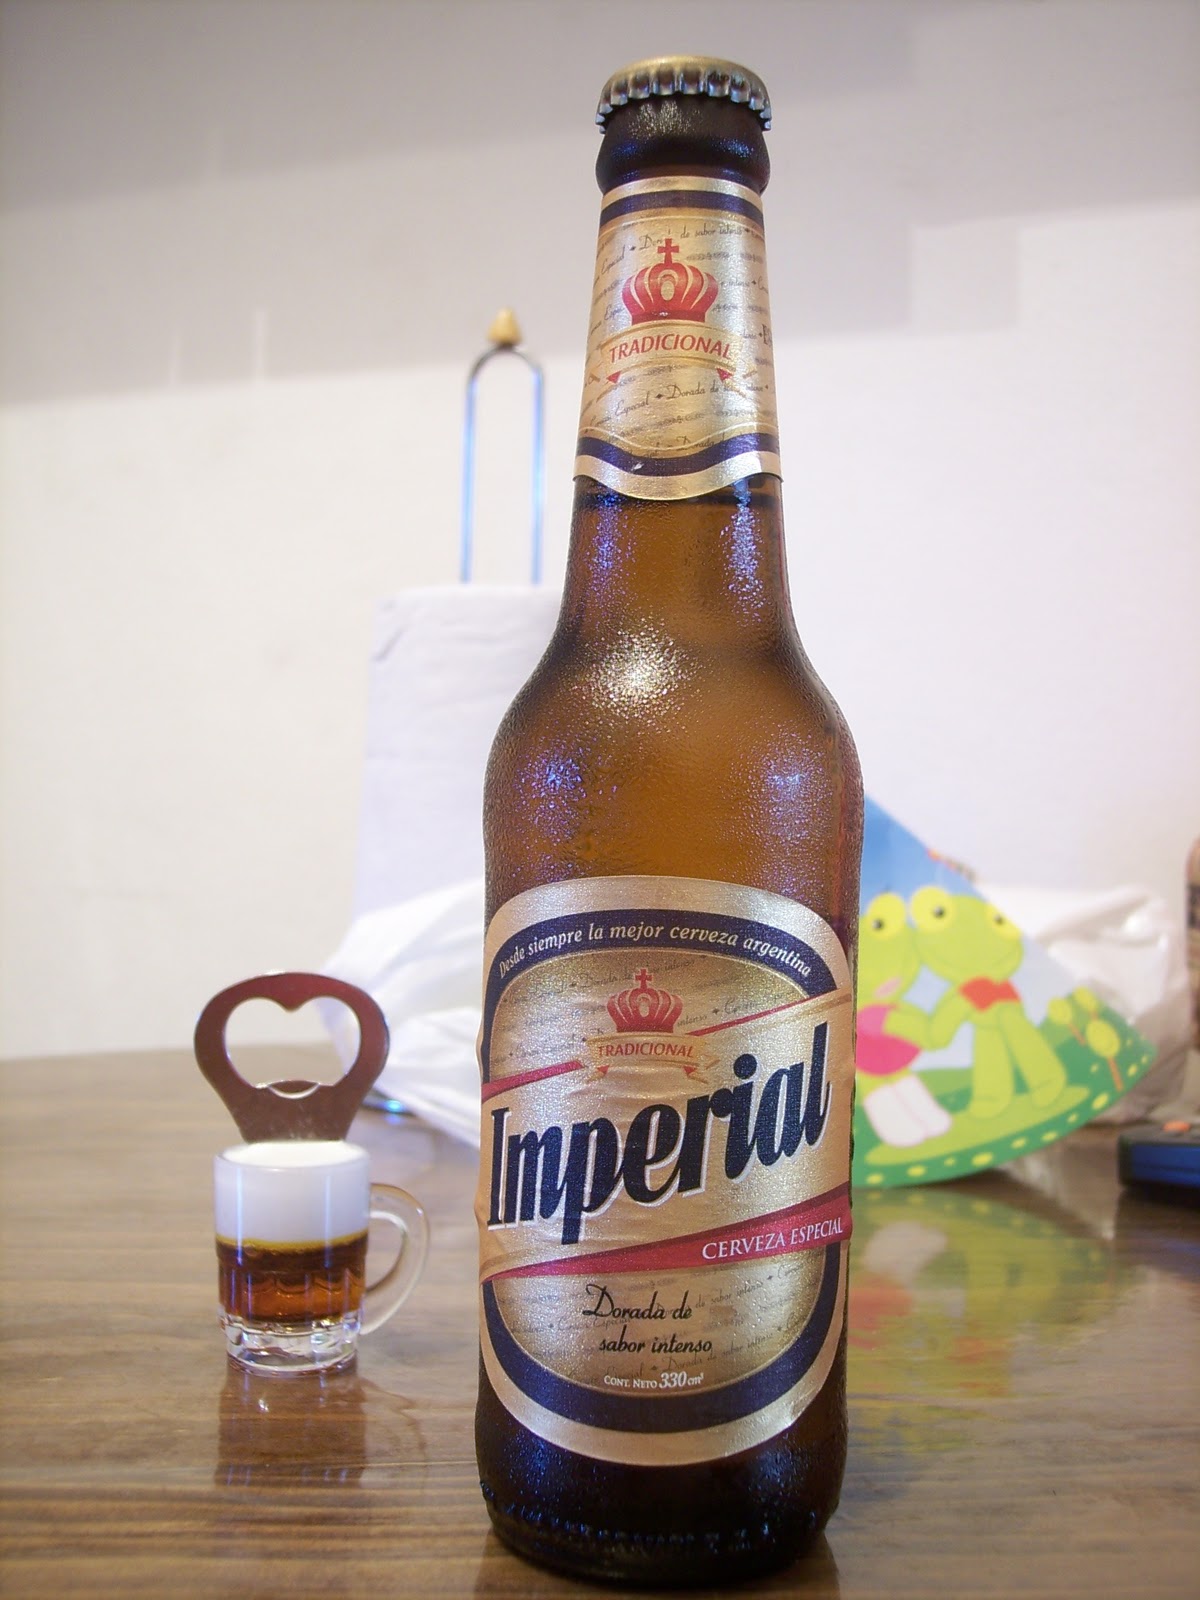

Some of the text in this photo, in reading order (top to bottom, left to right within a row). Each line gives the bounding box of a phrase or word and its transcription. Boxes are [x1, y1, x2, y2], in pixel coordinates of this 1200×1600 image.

[680, 225, 690, 239] de
[609, 333, 731, 363] TRADICIONAL
[666, 381, 706, 400] Dorada
[710, 379, 720, 394] de
[499, 922, 812, 980] Desde siempre la mejor cerveza argentina
[598, 1041, 695, 1059] TRADICIONAL
[487, 1021, 833, 1246] Imperial
[701, 1216, 844, 1260] CERVEZA ESPECIAL
[581, 1283, 693, 1320] Dorada de
[598, 1323, 646, 1354] sabor
[650, 1333, 713, 1354] intenso
[603, 1375, 632, 1389] CONT.
[632, 1377, 658, 1390] NETO
[658, 1371, 688, 1390] 330
